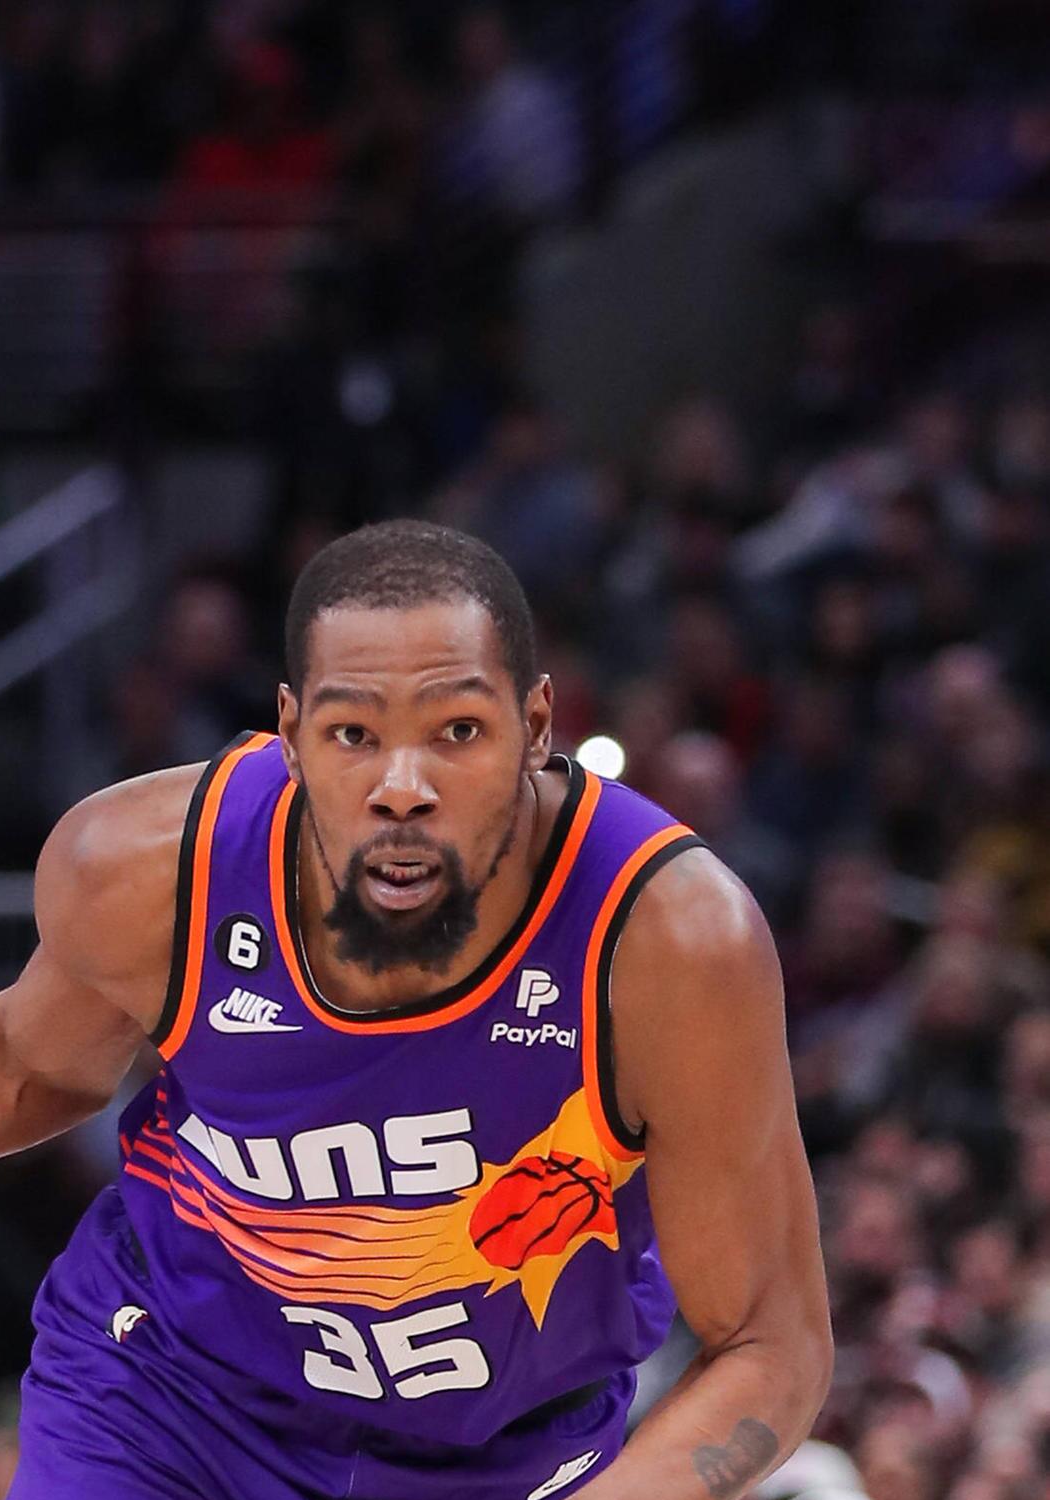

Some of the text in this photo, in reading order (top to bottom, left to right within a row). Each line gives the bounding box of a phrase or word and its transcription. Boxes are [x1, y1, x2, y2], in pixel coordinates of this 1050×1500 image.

[228, 921, 261, 969] 6
[222, 987, 283, 1025] NIKE
[490, 1023, 577, 1049] PayPal
[280, 1302, 490, 1399] 35
